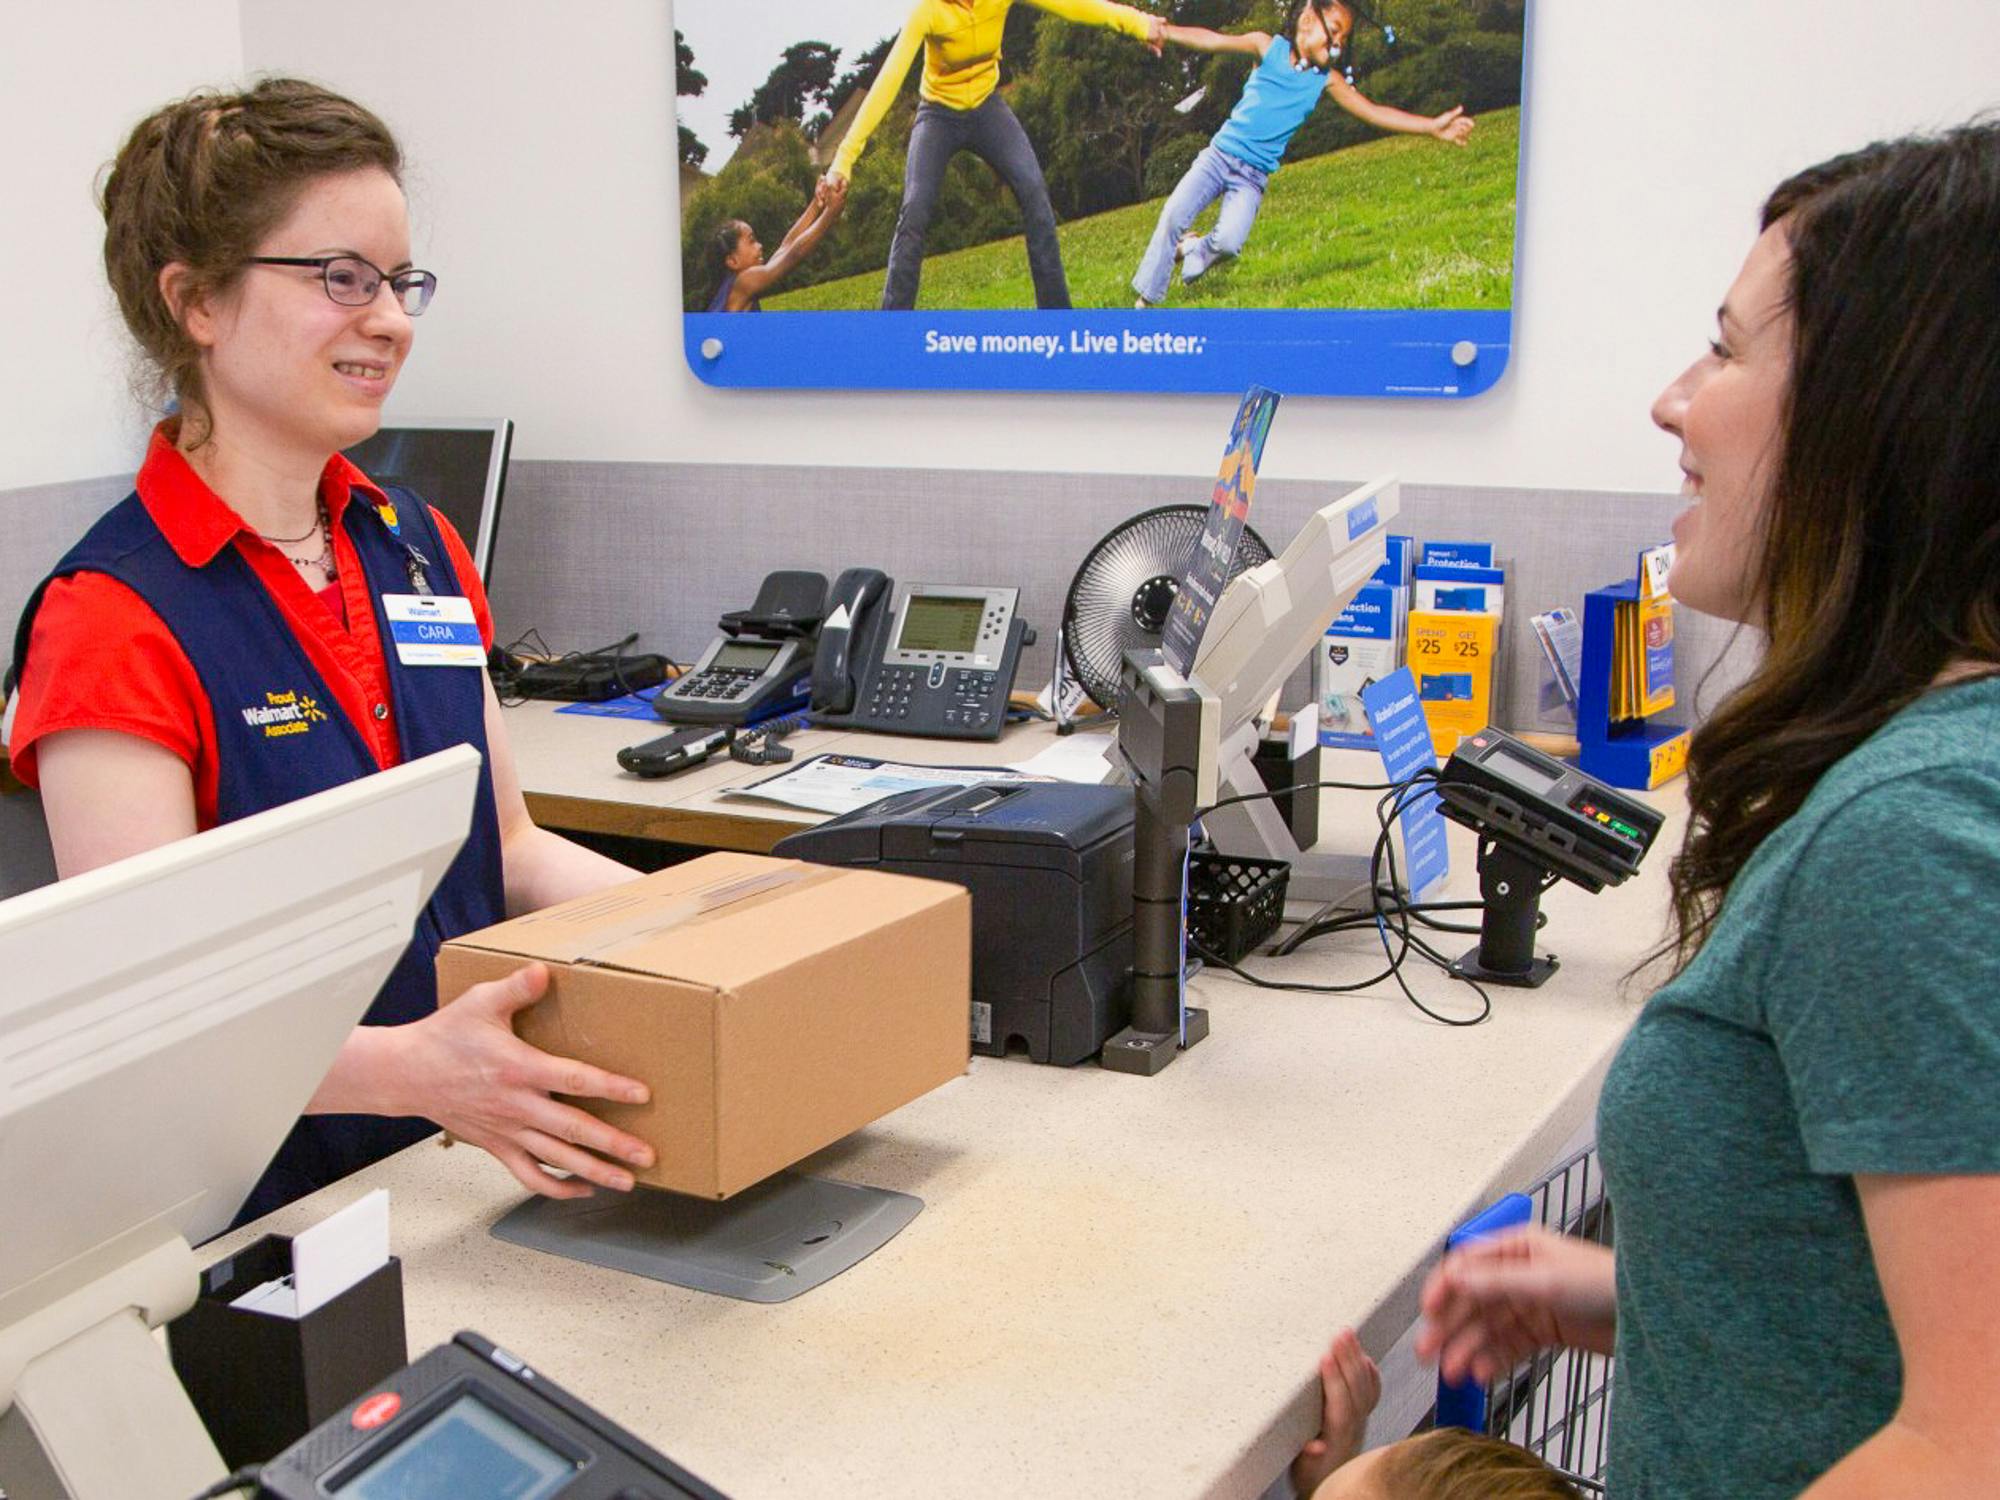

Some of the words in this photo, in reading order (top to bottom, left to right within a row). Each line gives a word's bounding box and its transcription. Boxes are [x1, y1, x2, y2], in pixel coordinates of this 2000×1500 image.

[925, 329, 977, 353] Save
[981, 330, 1064, 359] money.
[1071, 329, 1118, 354] Live
[1123, 329, 1204, 354] better.
[1345, 601, 1381, 614] tection
[417, 624, 455, 640] CARA
[1416, 639, 1441, 655] $25
[1454, 641, 1480, 658] $25
[266, 689, 297, 705] Proud
[242, 702, 303, 726] Walmart
